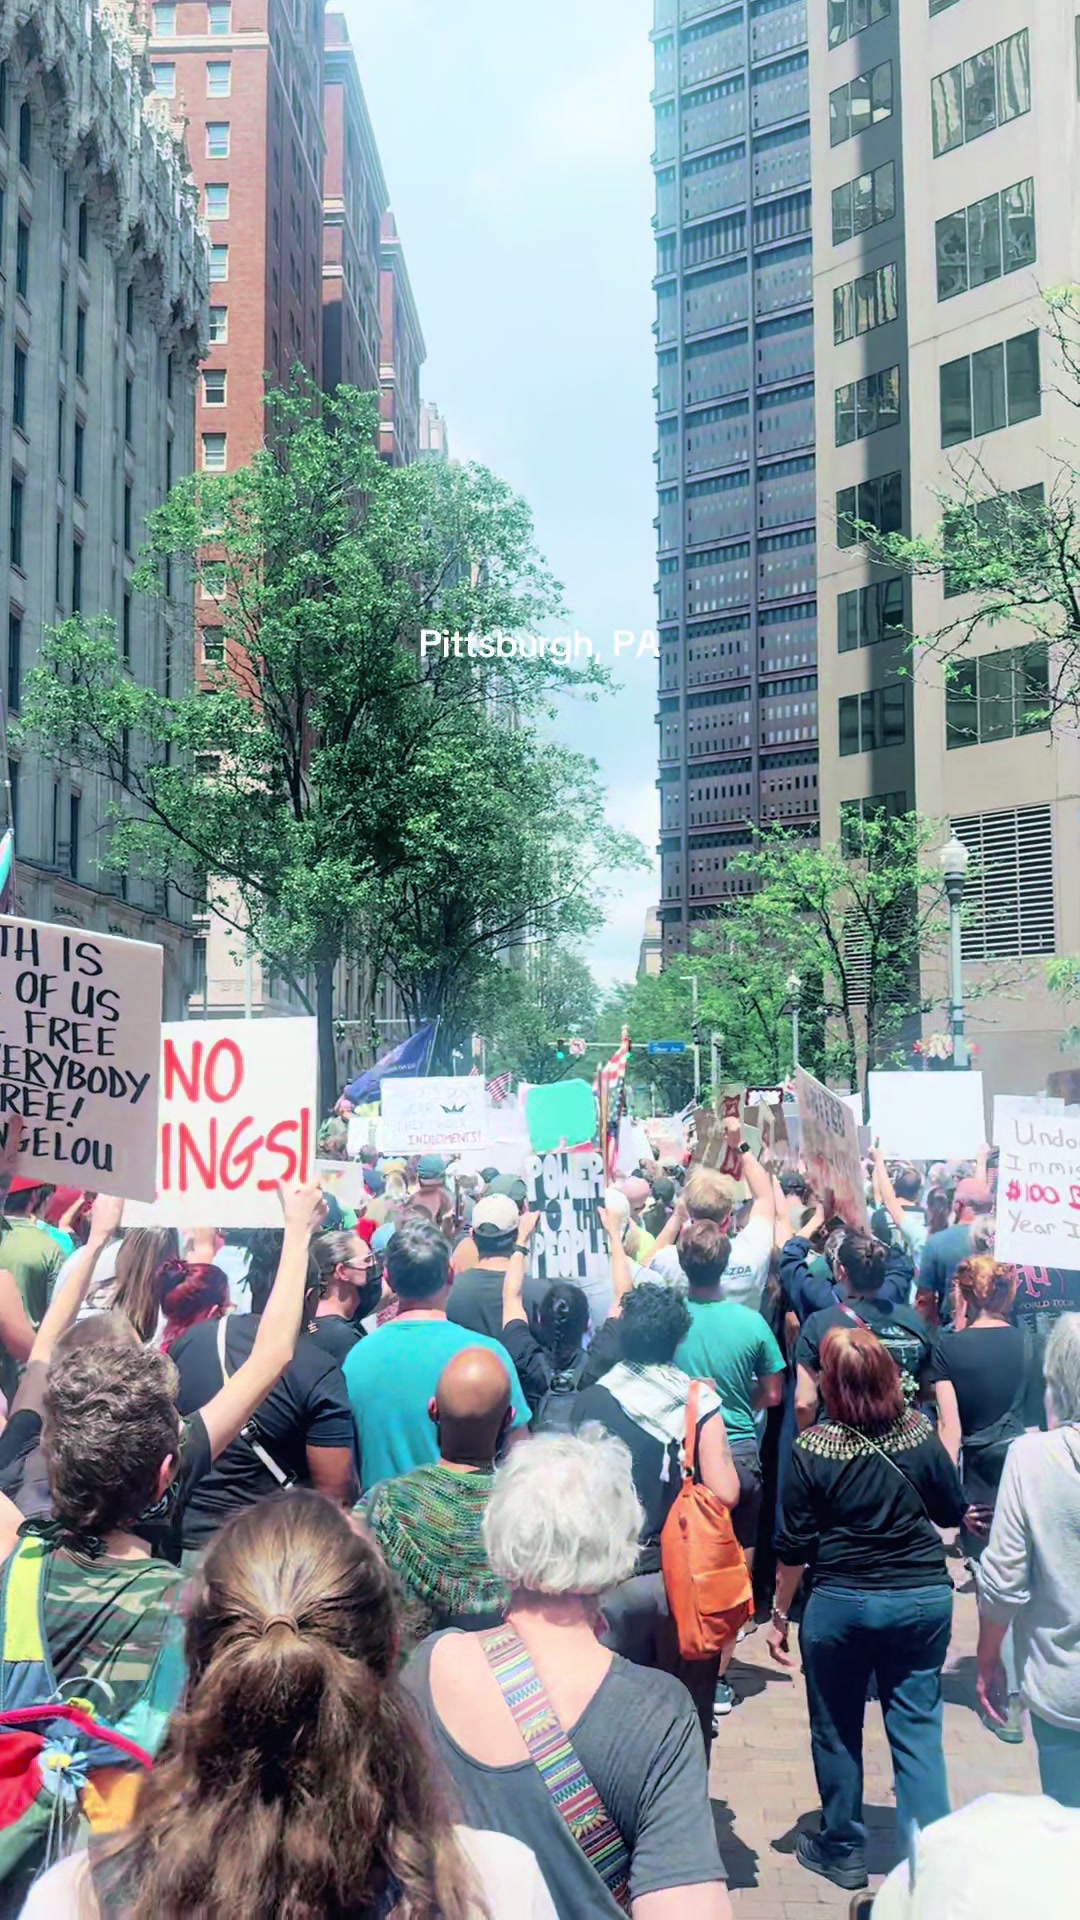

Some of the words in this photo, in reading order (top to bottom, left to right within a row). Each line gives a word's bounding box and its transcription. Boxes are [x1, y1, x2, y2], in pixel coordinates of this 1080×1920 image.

[63, 936, 103, 976] IS
[15, 971, 58, 1008] OF
[71, 981, 120, 1022] US
[24, 1010, 117, 1056] FREE
[0, 1044, 150, 1104] ERYBODY
[164, 1037, 244, 1103] NO
[524, 1152, 606, 1202] POWER
[1005, 1179, 1060, 1205] $100
[1008, 1209, 1056, 1235] Year
[531, 1229, 612, 1279] PEOPLE
